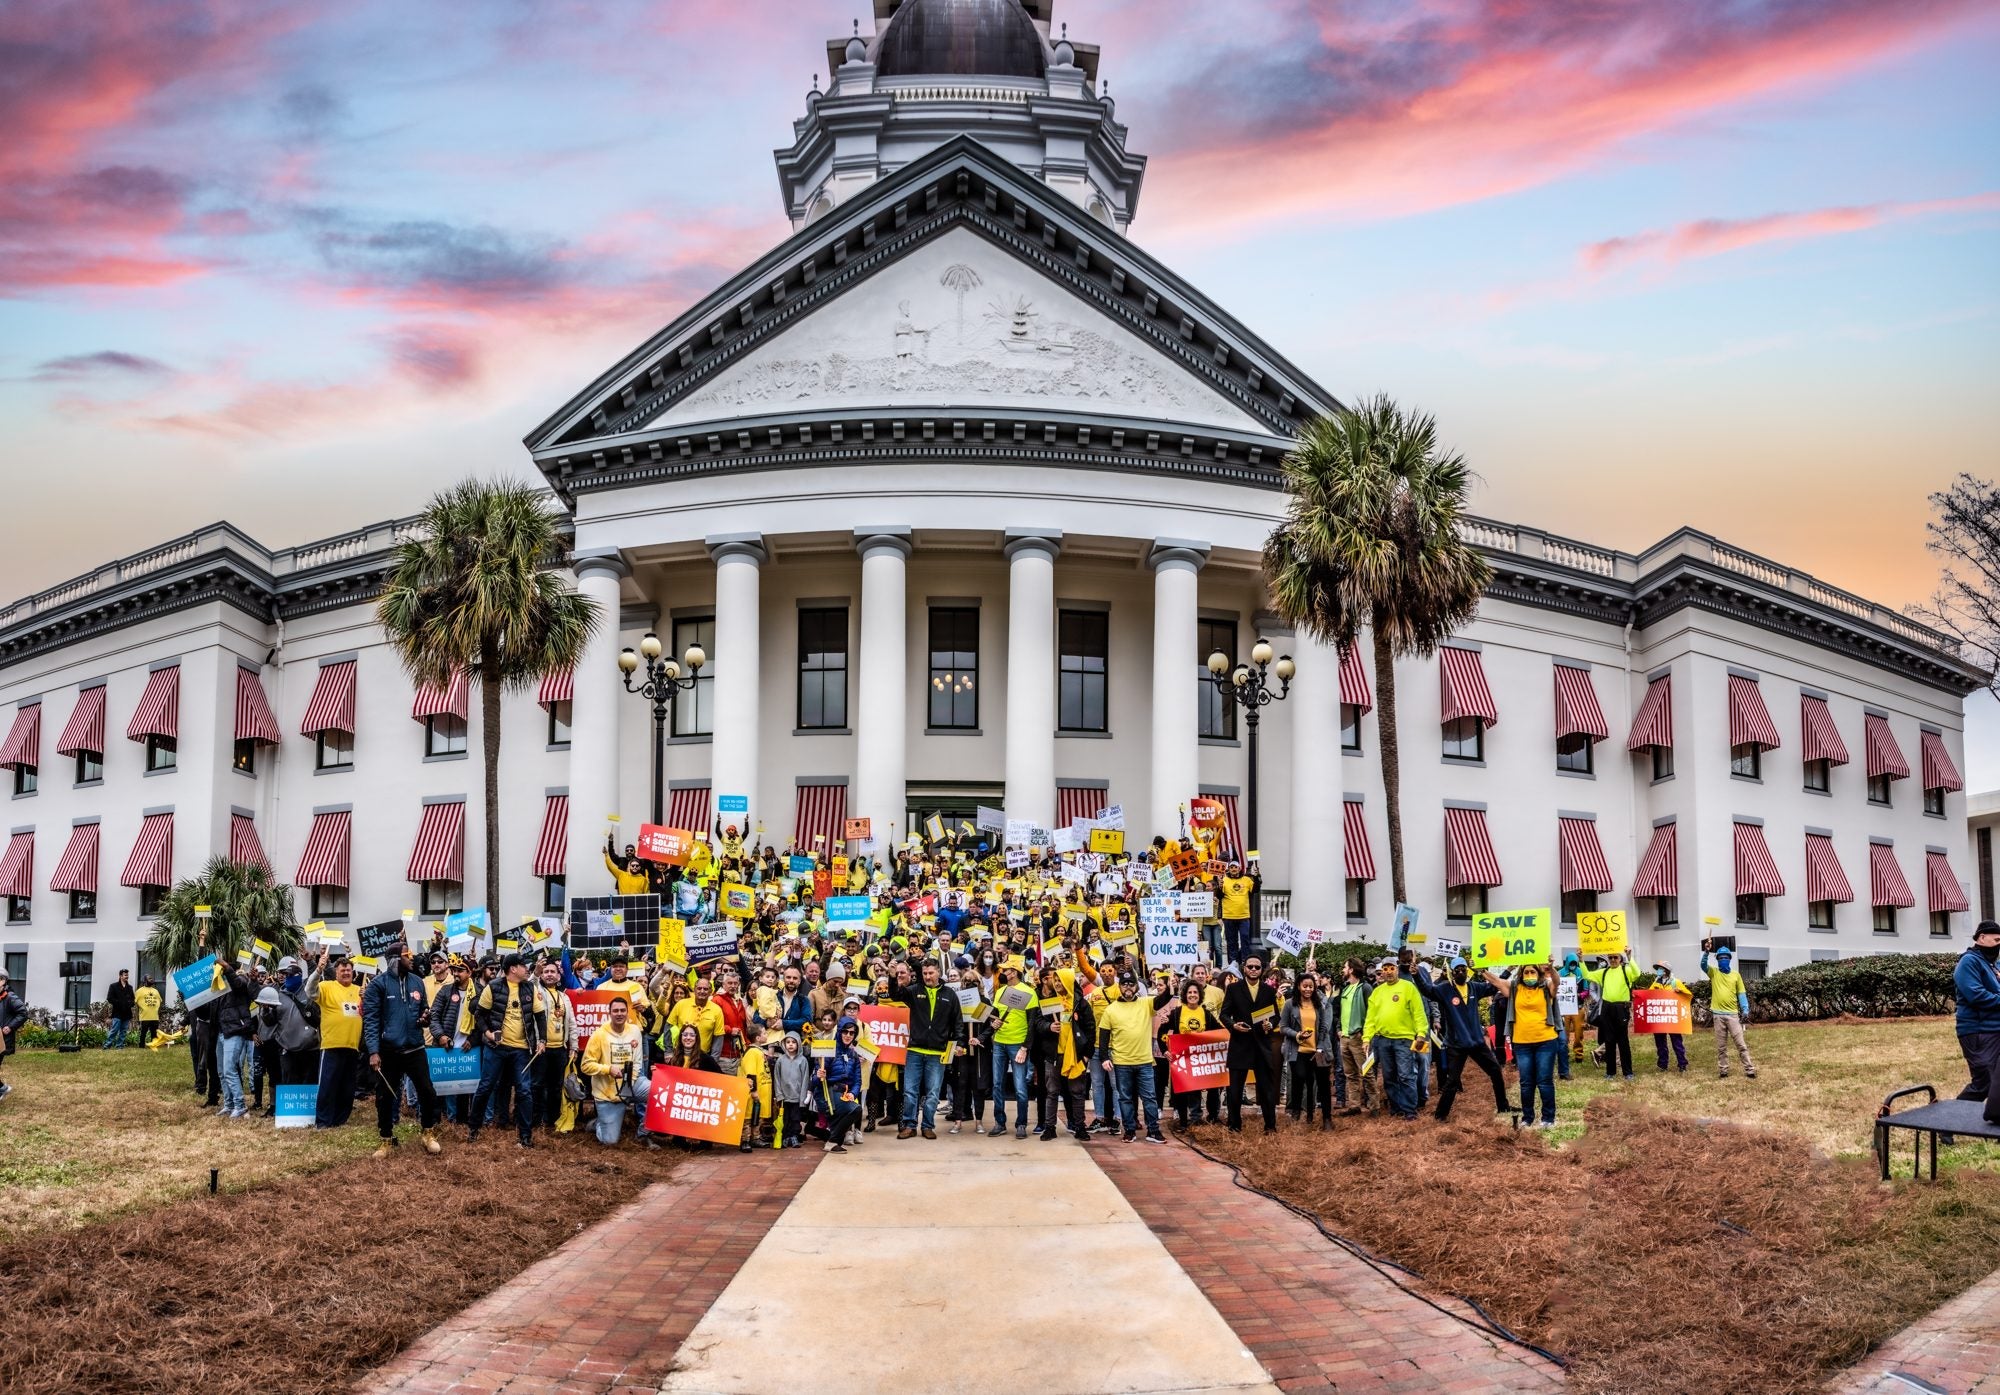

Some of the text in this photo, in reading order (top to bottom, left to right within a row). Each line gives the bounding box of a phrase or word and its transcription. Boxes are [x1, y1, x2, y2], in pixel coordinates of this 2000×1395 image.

[654, 832, 680, 842] PROTECT
[652, 838, 679, 849] SOLAR
[652, 845, 678, 856] RIGHTS
[1478, 915, 1537, 929] SAVE
[1582, 915, 1620, 934] SOS
[361, 926, 378, 937] Net
[693, 931, 728, 940] SOLAR
[1152, 925, 1188, 936] SAVE
[1280, 922, 1301, 939] SAVE
[369, 932, 402, 946] Meterin
[1271, 929, 1302, 951] OUR JOBS
[659, 938, 670, 959] Save
[706, 944, 735, 953] 800-6765
[1151, 944, 1197, 955] OUR JOBS
[182, 975, 193, 984] RUN
[193, 971, 201, 979] MY
[204, 974, 213, 982] SU
[577, 1004, 610, 1012] PROTEC
[1647, 1006, 1678, 1015] SOLAR
[576, 1014, 609, 1025] SOLA
[870, 1020, 909, 1035] SOLA
[1189, 1042, 1229, 1053] PROTECT
[458, 1055, 477, 1063] HOME
[675, 1082, 723, 1098] PROTECT
[673, 1093, 721, 1112] SOLAR
[670, 1107, 719, 1125] RIGHTS
